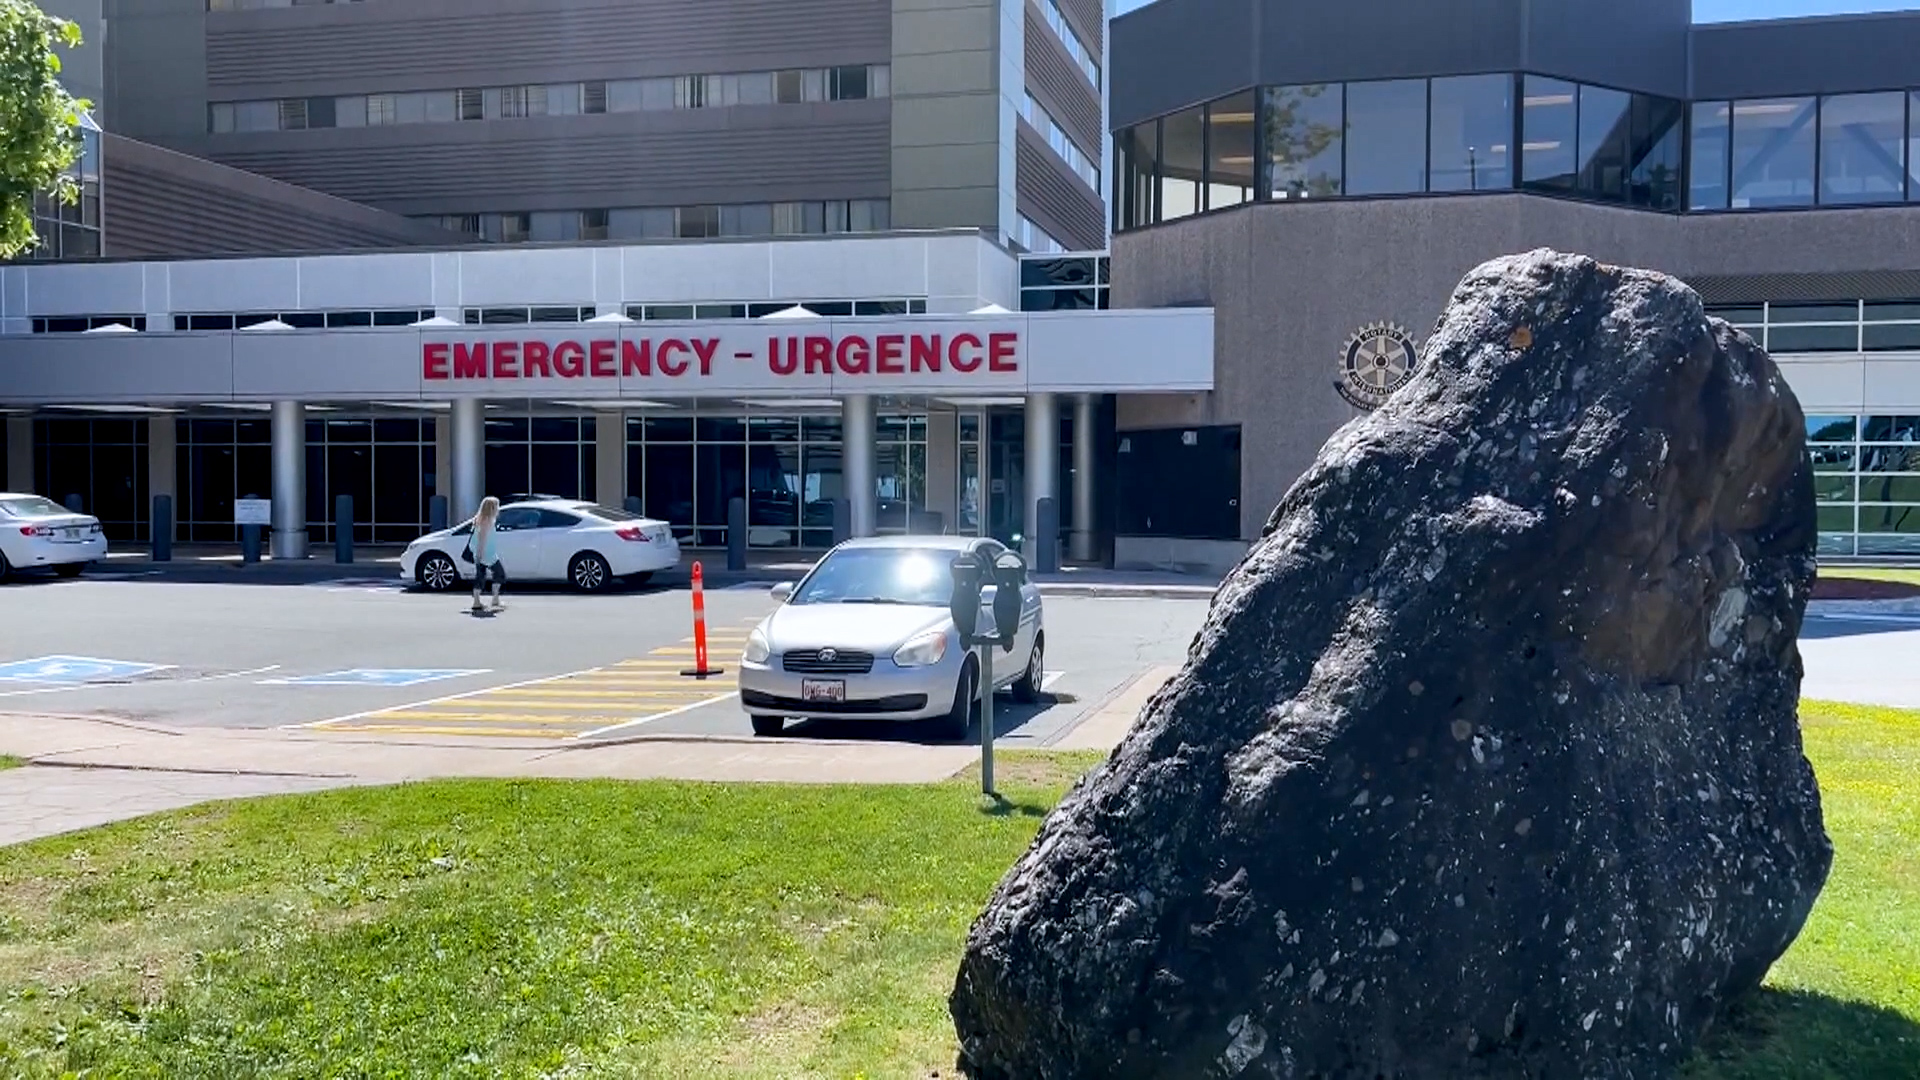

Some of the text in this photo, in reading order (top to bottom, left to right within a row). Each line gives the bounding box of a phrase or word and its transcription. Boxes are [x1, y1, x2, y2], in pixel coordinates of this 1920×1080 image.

[1364, 327, 1399, 340] ROTARY
[423, 338, 720, 379] EMERGENCY
[768, 332, 1018, 376] URGENCE
